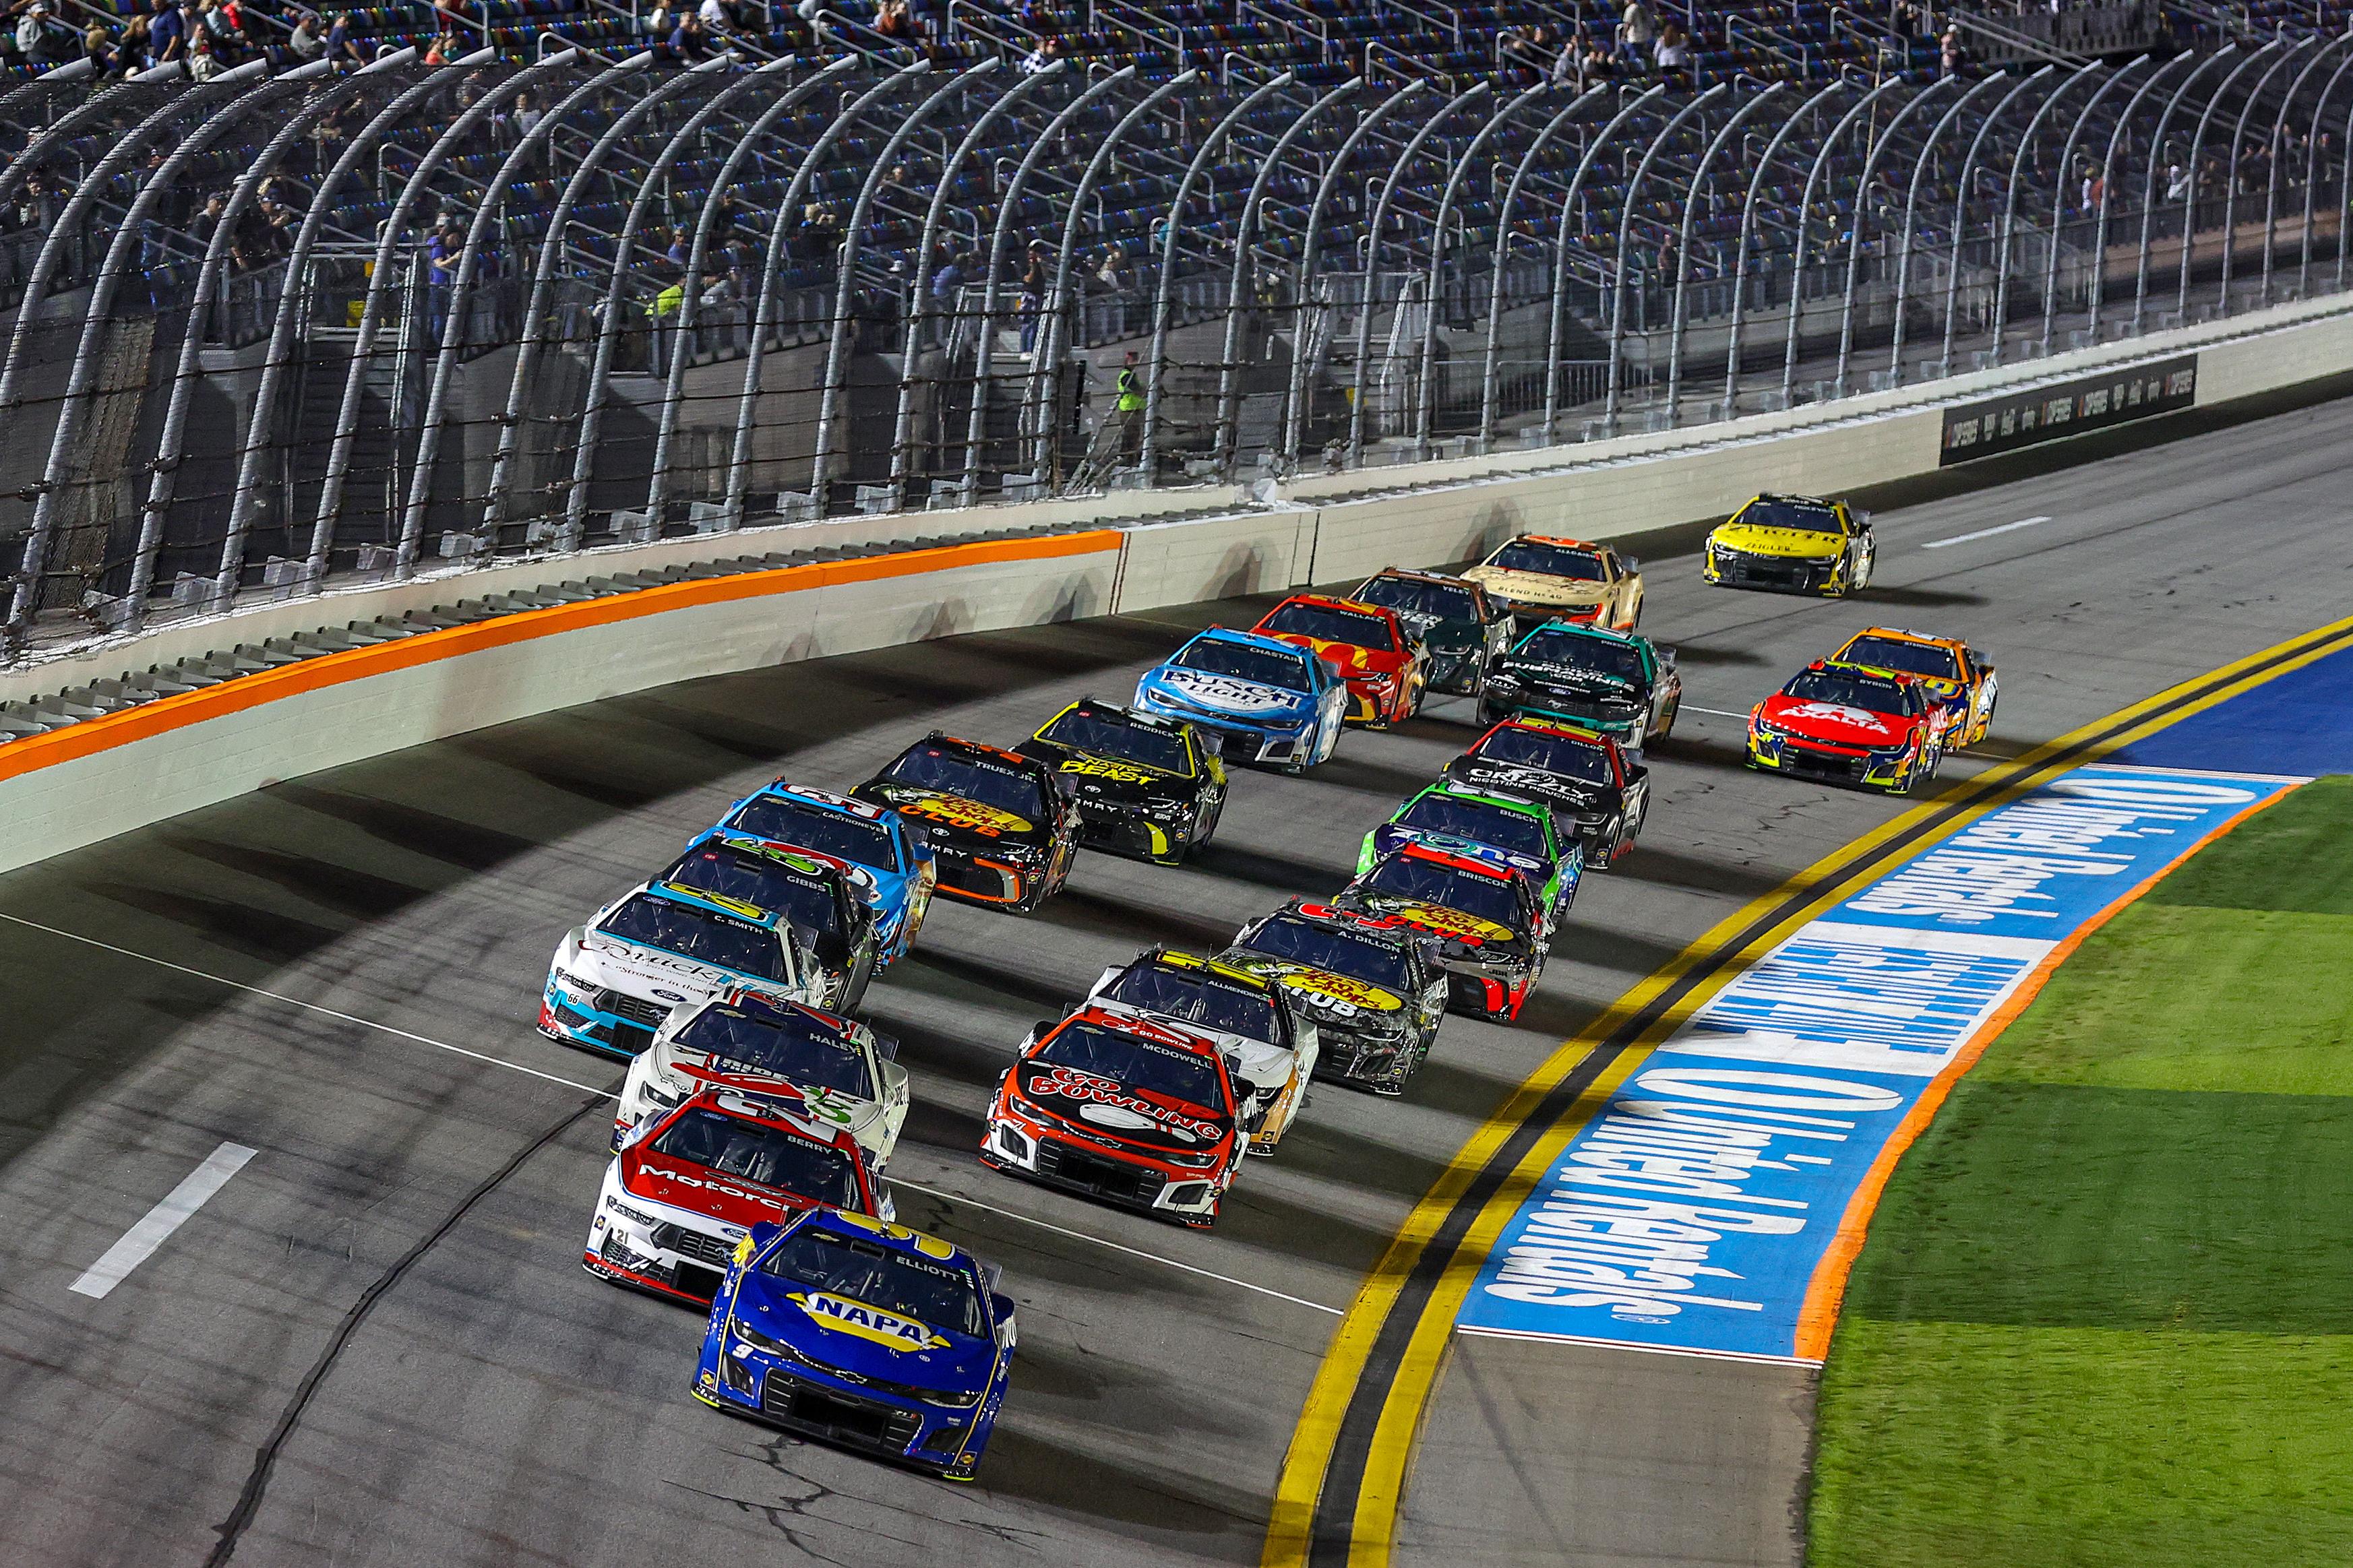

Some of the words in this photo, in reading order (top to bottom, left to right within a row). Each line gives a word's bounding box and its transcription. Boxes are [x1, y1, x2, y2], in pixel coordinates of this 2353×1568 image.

[1498, 586, 1531, 595] BLEND
[1160, 670, 1302, 709] BUSCH
[1188, 685, 1264, 704] LIGHT
[1130, 722, 1175, 739] REDDICK
[1777, 708, 1889, 734] AXALTA
[975, 760, 1015, 777] TRUEX
[1018, 774, 1037, 783] JR.
[1058, 761, 1160, 785] BEAST
[1469, 776, 1526, 789] NICOTINE
[1529, 785, 1585, 807] POUCHES
[1074, 798, 1118, 813] AMRY
[1500, 809, 1538, 824] BUSCH
[898, 805, 1002, 838] CLUB
[1949, 796, 2209, 860] United
[921, 841, 968, 858] AMRY
[787, 875, 826, 893] GIBBS
[1457, 870, 1508, 889] BRISCOE
[1845, 848, 2129, 921] Rentals
[714, 914, 725, 923] C.
[728, 919, 763, 935] SMITH
[1337, 930, 1351, 939] A.
[1355, 935, 1401, 953] DILLON
[568, 993, 580, 1005] 66
[656, 989, 680, 1001] Ford
[809, 1032, 857, 1053] HALEY
[1139, 1030, 1153, 1038] GO
[1155, 1034, 1193, 1050] BOWLING
[1143, 1042, 1213, 1069] MCDOWELL
[1051, 1069, 1121, 1093] GO
[1029, 1075, 1223, 1140] BOWLING
[1012, 1119, 1026, 1131] 71
[787, 1135, 832, 1155] BERRY
[1559, 1100, 1856, 1209] United
[639, 1164, 791, 1212] Motorc
[616, 1228, 629, 1245] 21
[1484, 1189, 1808, 1317] Rentals
[896, 1255, 960, 1282] ELLIOTT
[815, 1296, 923, 1343] NAPA
[732, 1344, 754, 1359] 9
